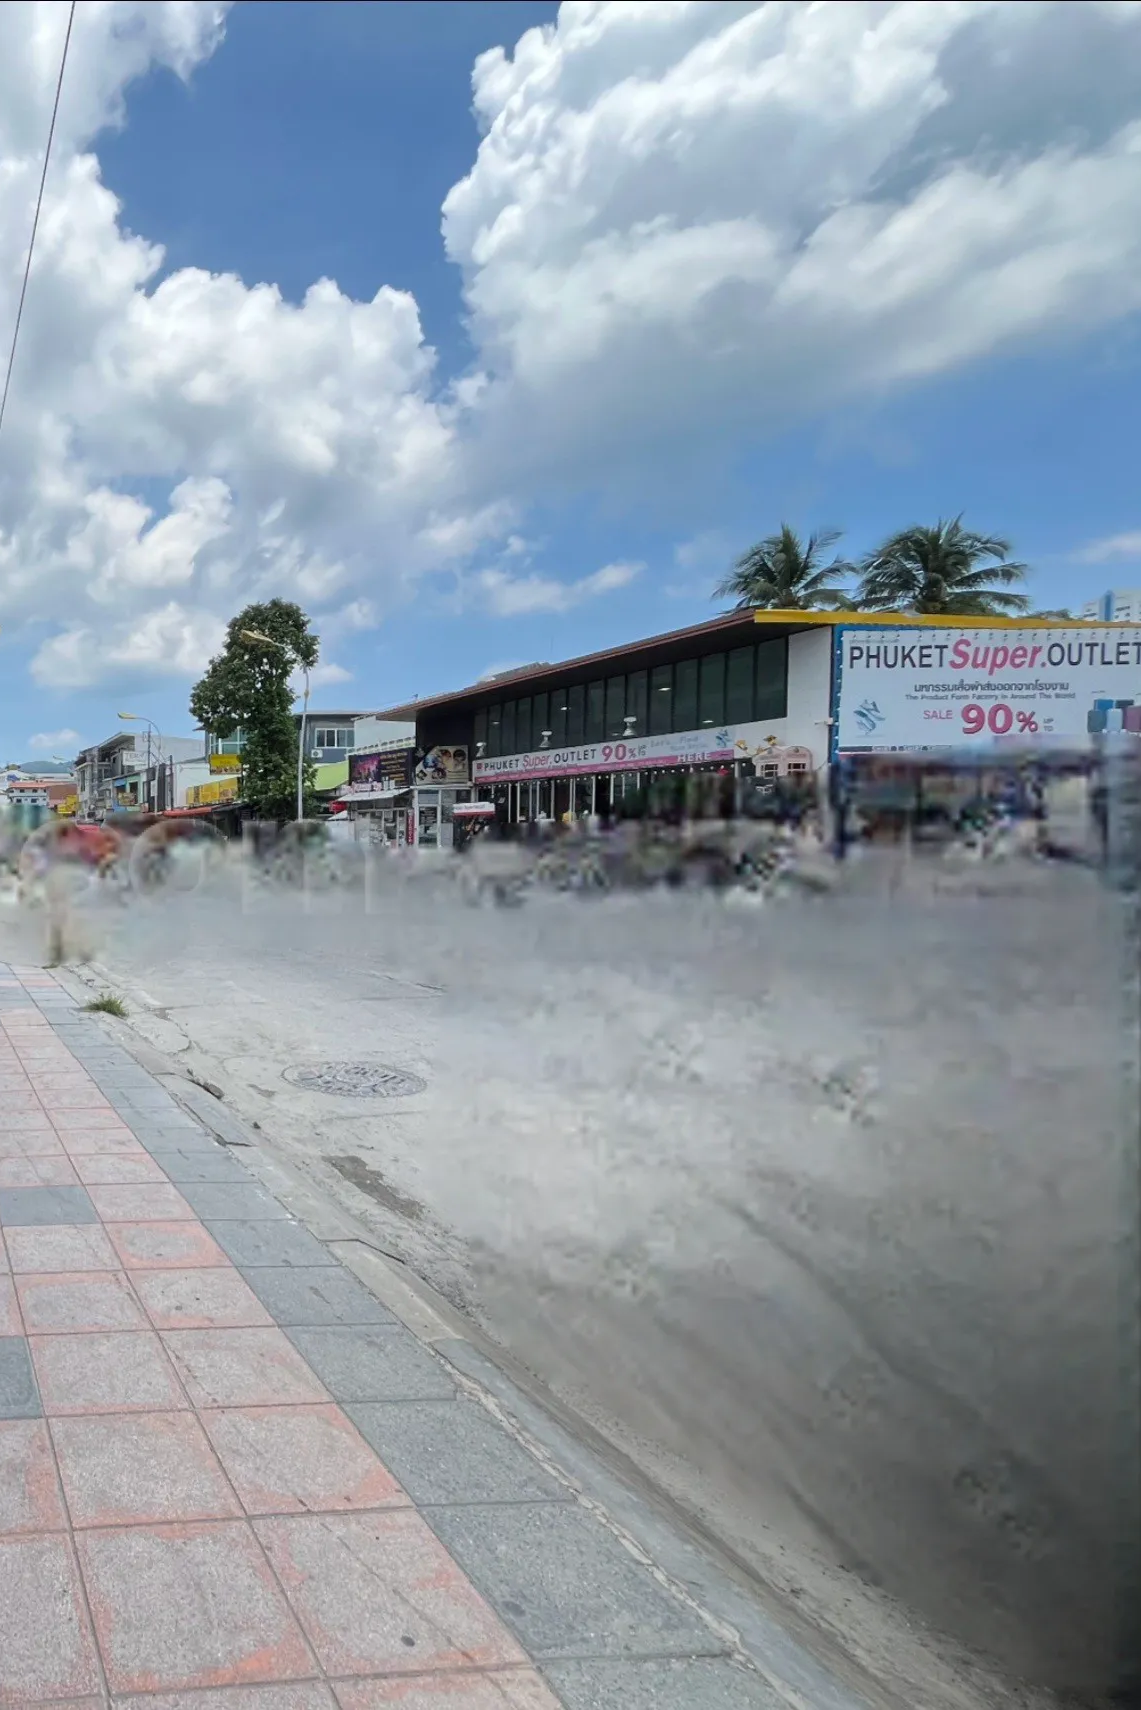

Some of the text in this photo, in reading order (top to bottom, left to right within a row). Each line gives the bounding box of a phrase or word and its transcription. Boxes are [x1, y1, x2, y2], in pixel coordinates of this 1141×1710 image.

[849, 643, 948, 669] PHUKET
[1048, 642, 1141, 667] OUTLET
[923, 709, 953, 720] SALE
[484, 759, 520, 771] PHUKET
[553, 749, 597, 764] OUTLET
